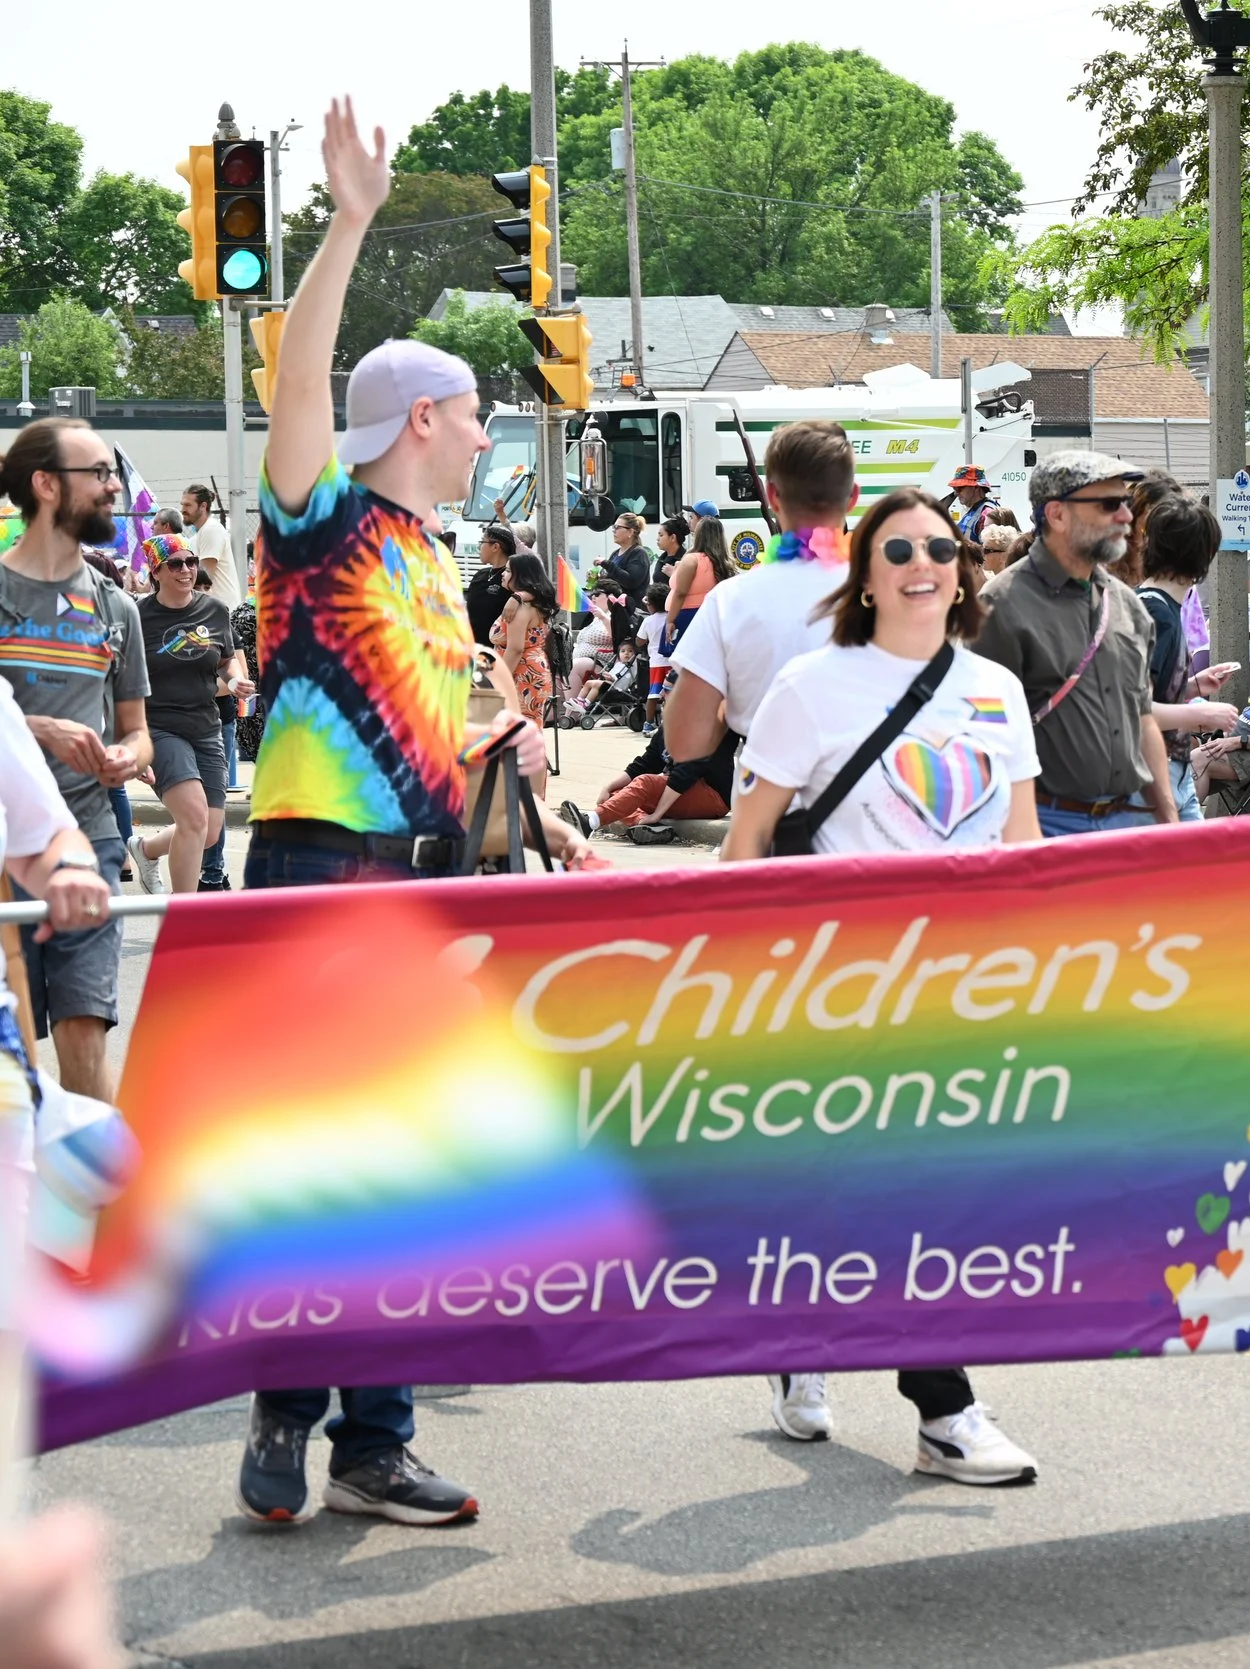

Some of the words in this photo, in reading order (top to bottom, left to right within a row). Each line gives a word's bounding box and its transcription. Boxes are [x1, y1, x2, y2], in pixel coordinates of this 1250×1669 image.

[886, 439, 920, 454] M4
[1001, 472, 1027, 482] 41050
[1222, 515, 1247, 523] Walking
[57, 621, 105, 645] Goo
[511, 915, 1203, 1053] Children's
[577, 1046, 1071, 1150] Wisconsin
[747, 1236, 878, 1305] the
[903, 1226, 1083, 1302] best.
